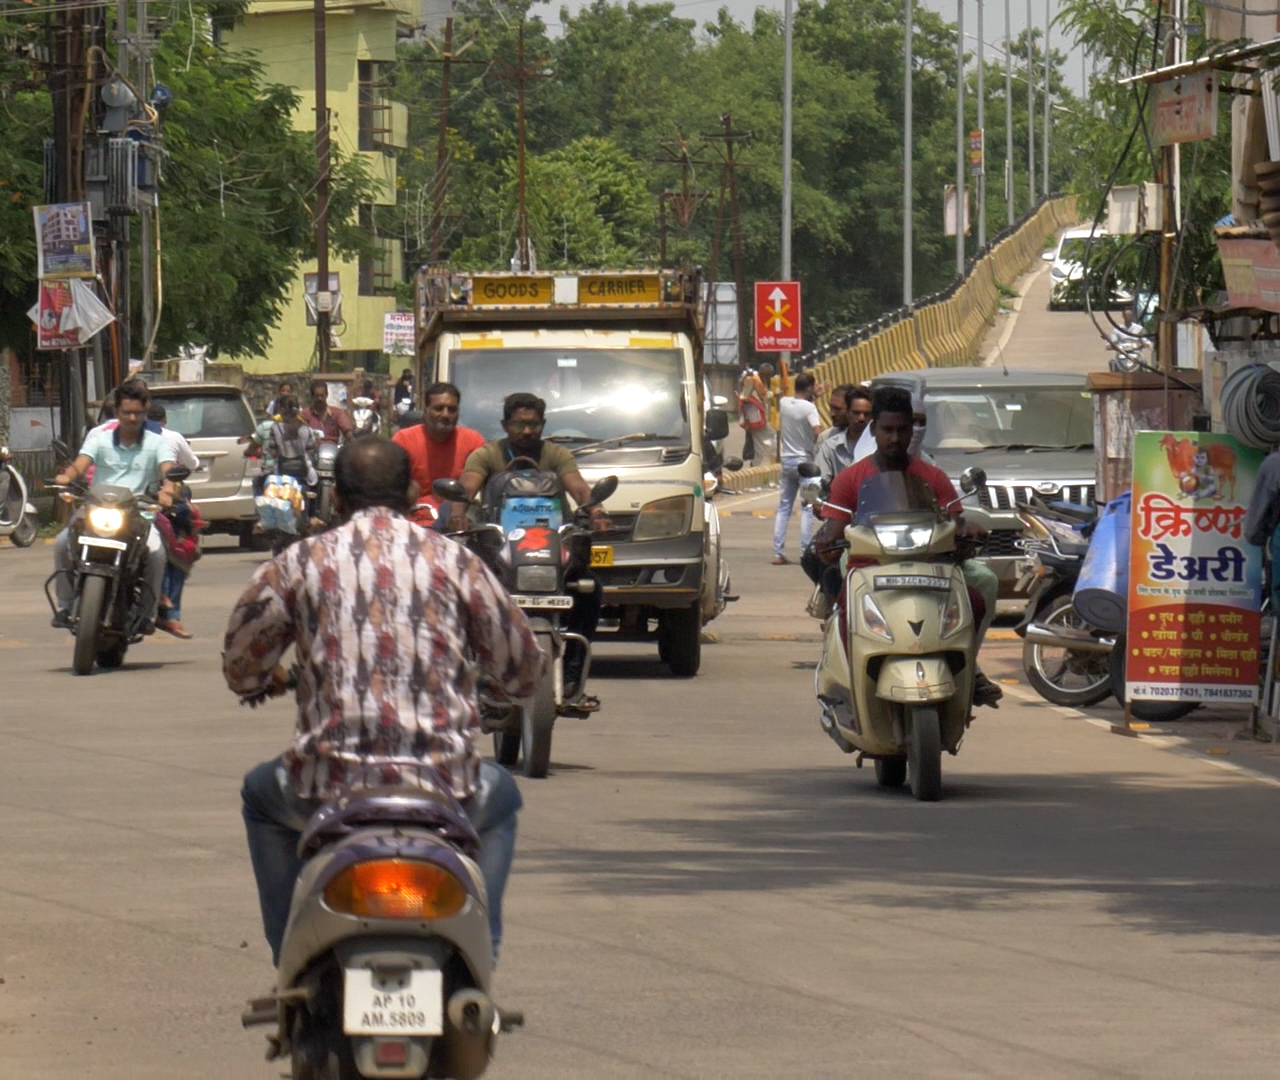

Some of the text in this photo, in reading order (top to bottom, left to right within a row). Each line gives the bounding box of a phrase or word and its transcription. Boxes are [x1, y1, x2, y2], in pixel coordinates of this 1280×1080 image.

[483, 279, 646, 299] GOODS CARRIER
[1150, 544, 1246, 582] डेअरी
[373, 993, 416, 1008] AP 10
